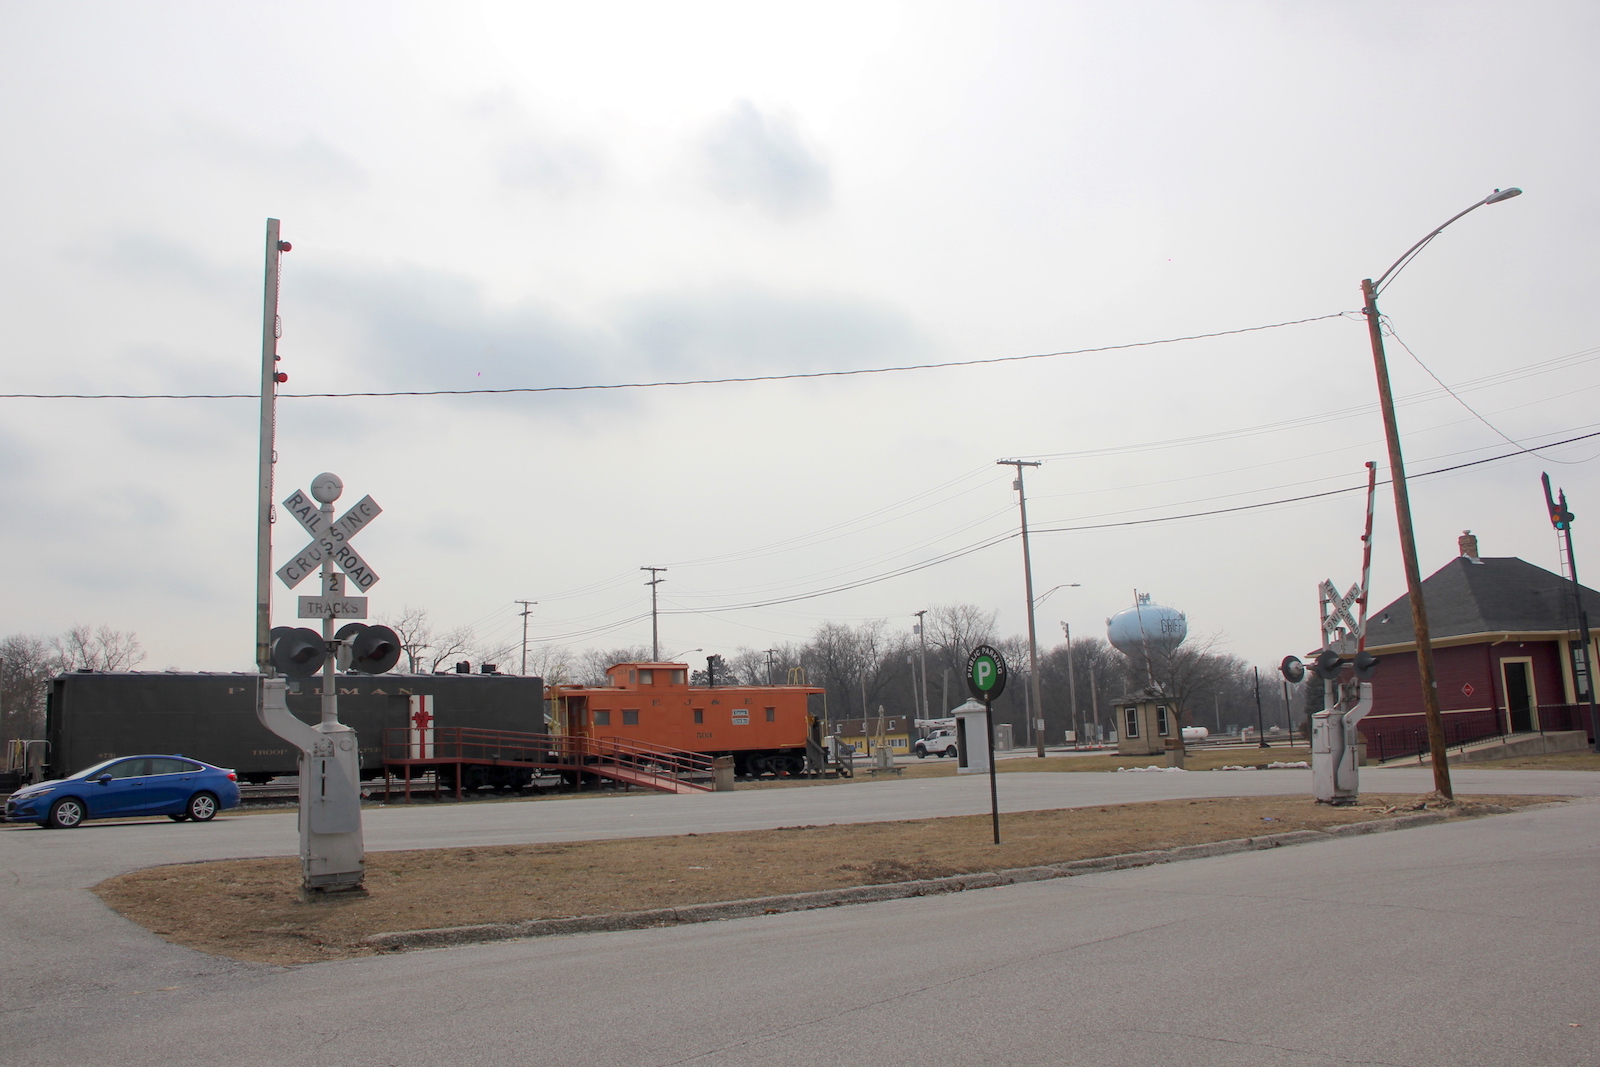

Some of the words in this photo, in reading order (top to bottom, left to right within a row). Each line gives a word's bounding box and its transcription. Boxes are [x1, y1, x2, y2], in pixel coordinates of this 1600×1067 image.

[287, 493, 322, 533] RAIL
[336, 546, 374, 589] ROAD
[329, 578, 339, 592] 2
[307, 602, 359, 614] TRACKS
[1323, 582, 1338, 603] RAIL
[1345, 613, 1360, 635] ROAD
[1327, 587, 1359, 630] CROSSING
[967, 649, 980, 678] PUBLIC
[981, 647, 1003, 675] PARKING
[977, 661, 991, 686] P
